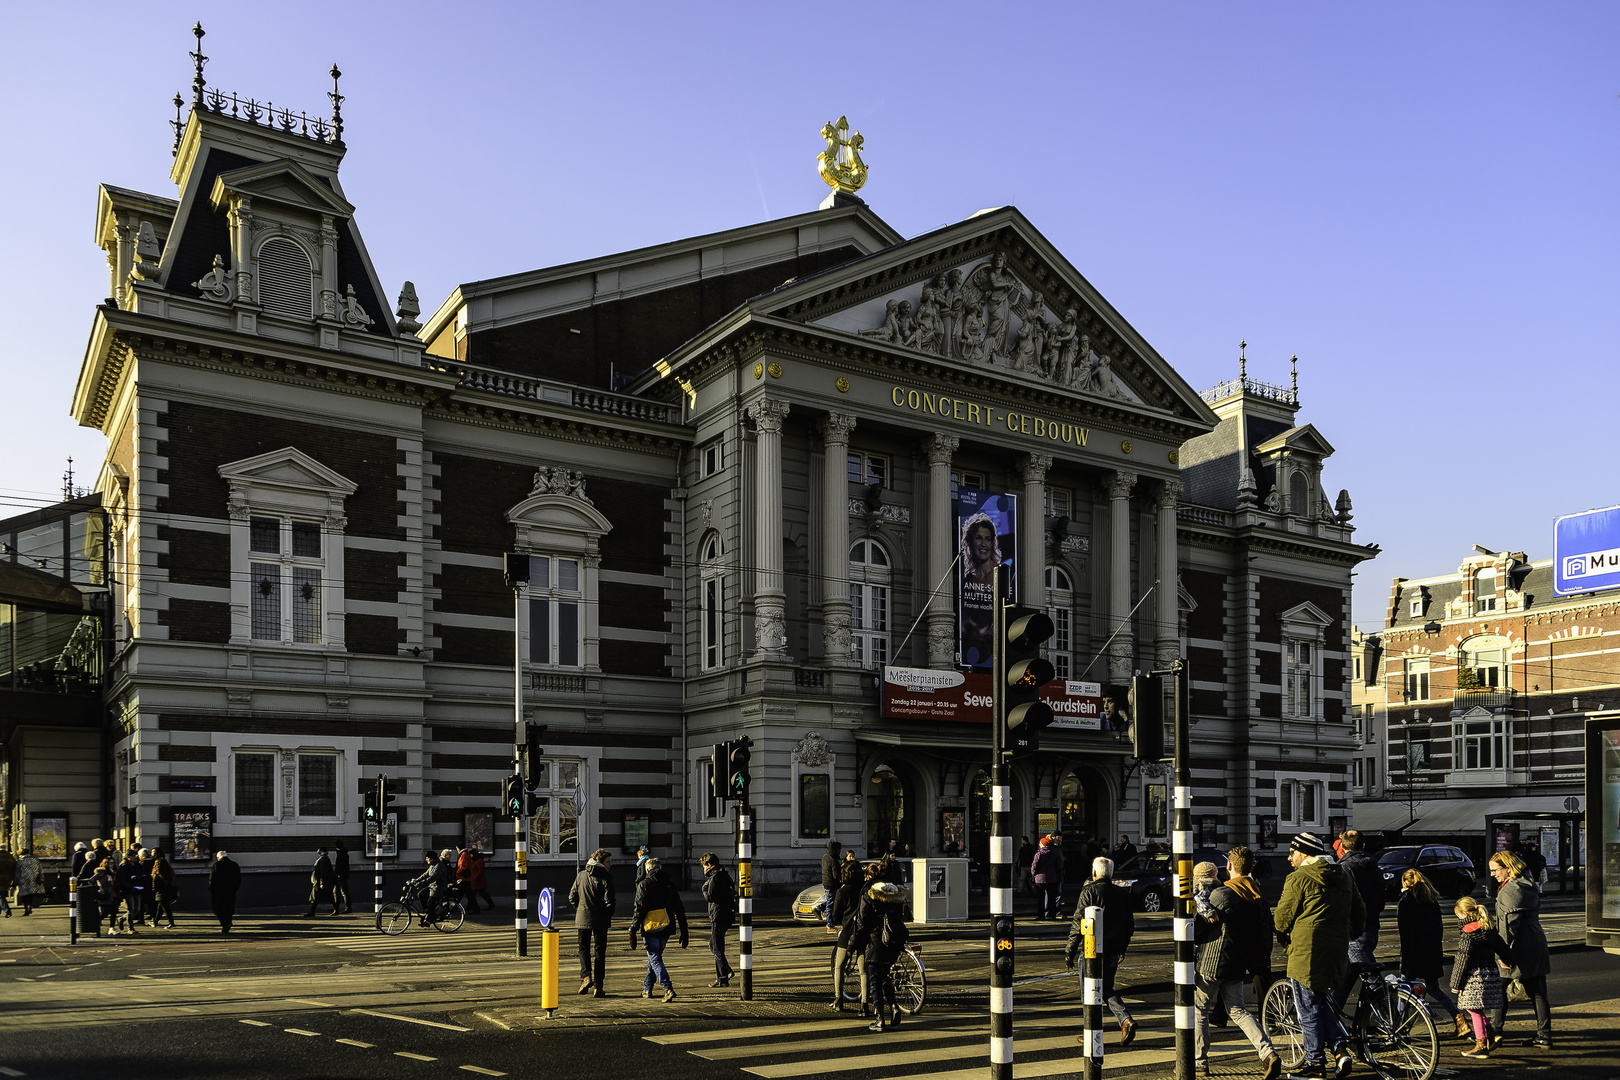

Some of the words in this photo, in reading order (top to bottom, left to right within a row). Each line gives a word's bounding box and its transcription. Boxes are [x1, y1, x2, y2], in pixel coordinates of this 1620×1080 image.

[963, 591, 993, 602] MUTTER
[889, 670, 953, 686] Meesterpianisten
[890, 698, 910, 706] Zondag
[917, 699, 934, 707] januari
[963, 690, 993, 708] Seve
[1038, 696, 1097, 715] kardstein
[890, 707, 927, 715] Concertgebouw
